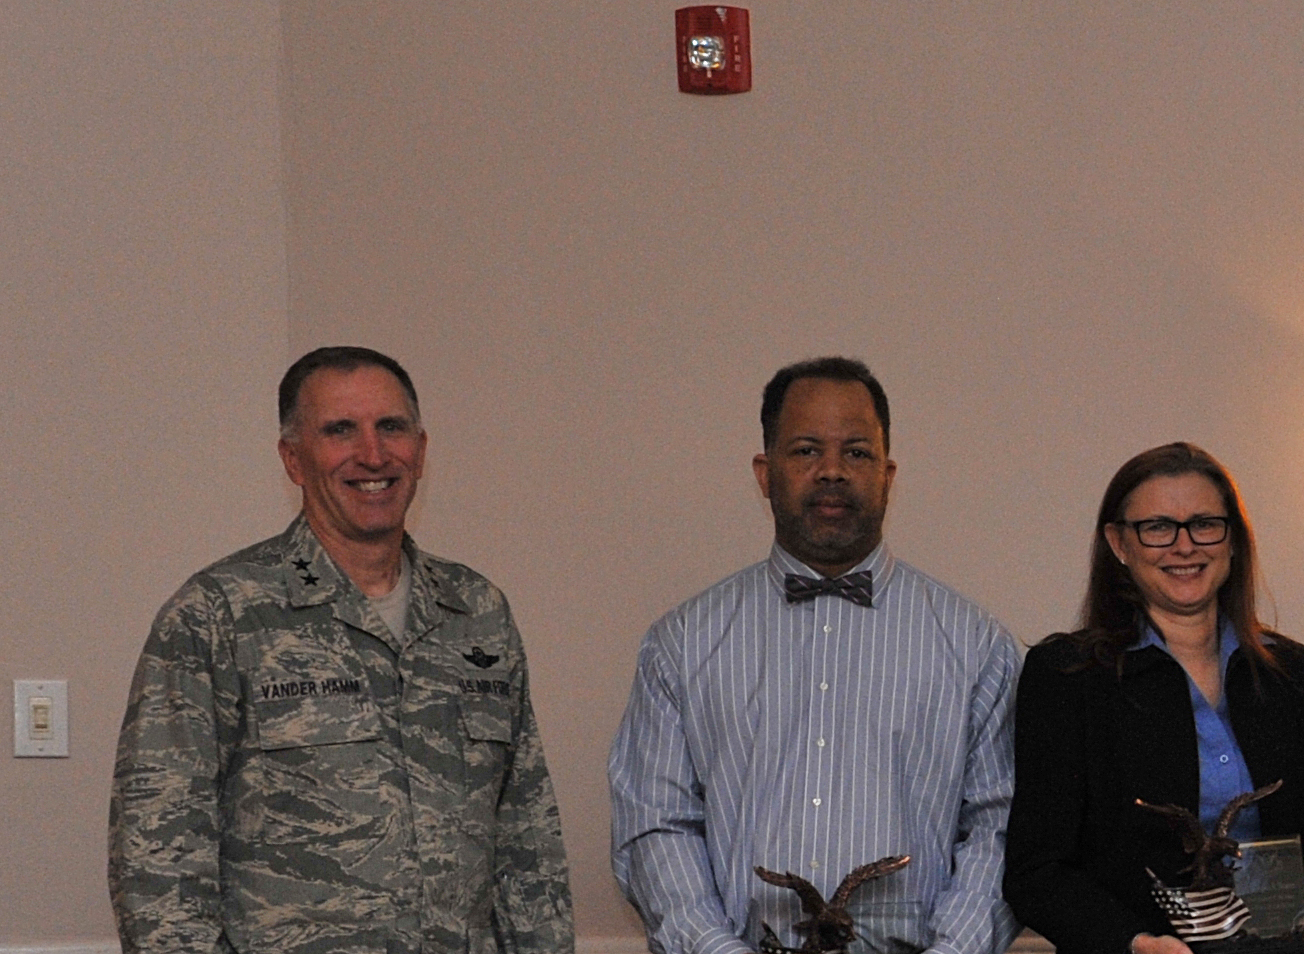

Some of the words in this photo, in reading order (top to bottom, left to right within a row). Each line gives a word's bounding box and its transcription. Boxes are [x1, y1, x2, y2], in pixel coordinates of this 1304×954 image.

[733, 35, 741, 72] FIRE
[261, 681, 318, 699] VANDER
[321, 679, 361, 694] HAMM
